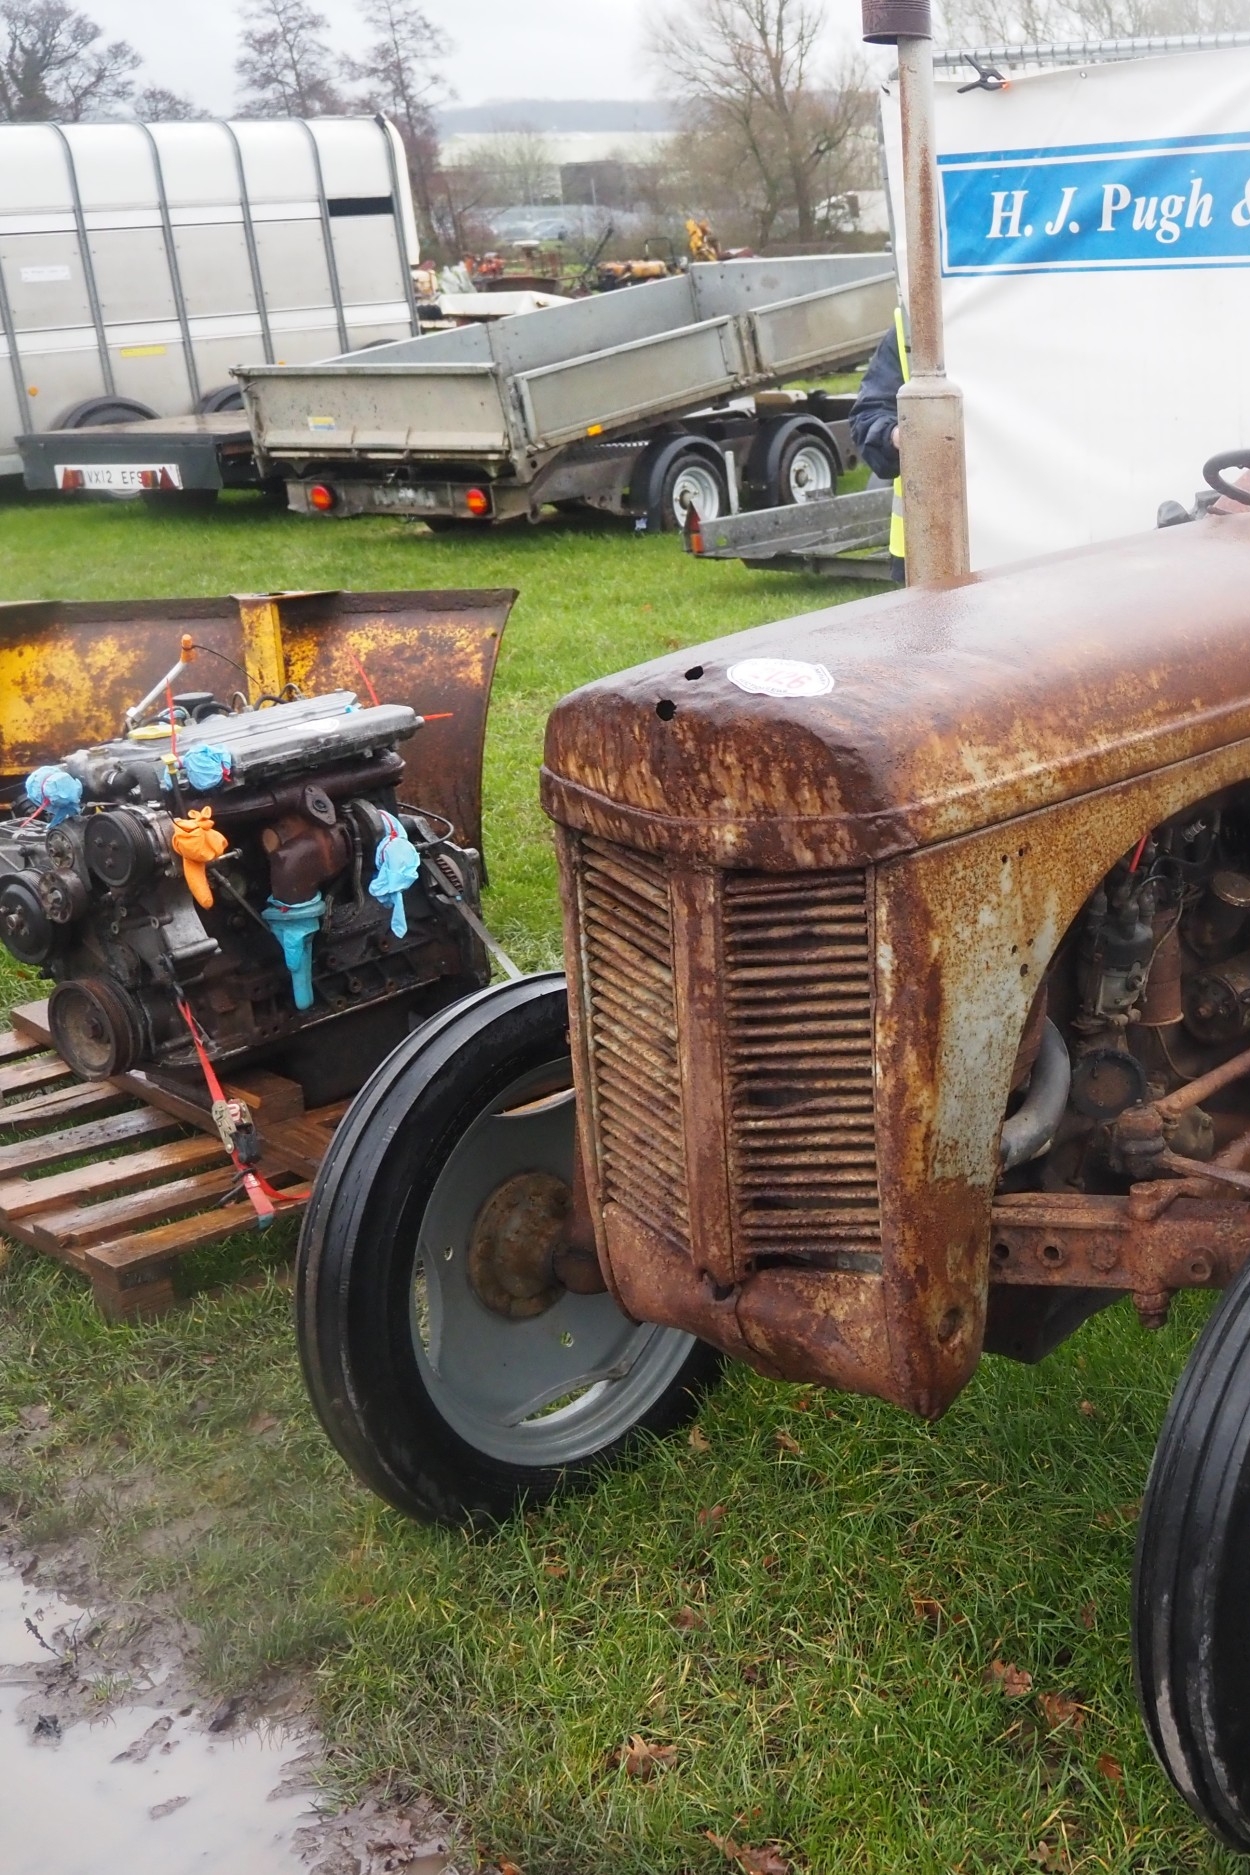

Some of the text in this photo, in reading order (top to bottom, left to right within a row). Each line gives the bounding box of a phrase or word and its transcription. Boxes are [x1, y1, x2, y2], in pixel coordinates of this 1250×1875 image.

[987, 190, 1034, 239] H.
[1045, 186, 1080, 236] J.
[1098, 178, 1213, 244] Pugh
[87, 469, 113, 485] VX12
